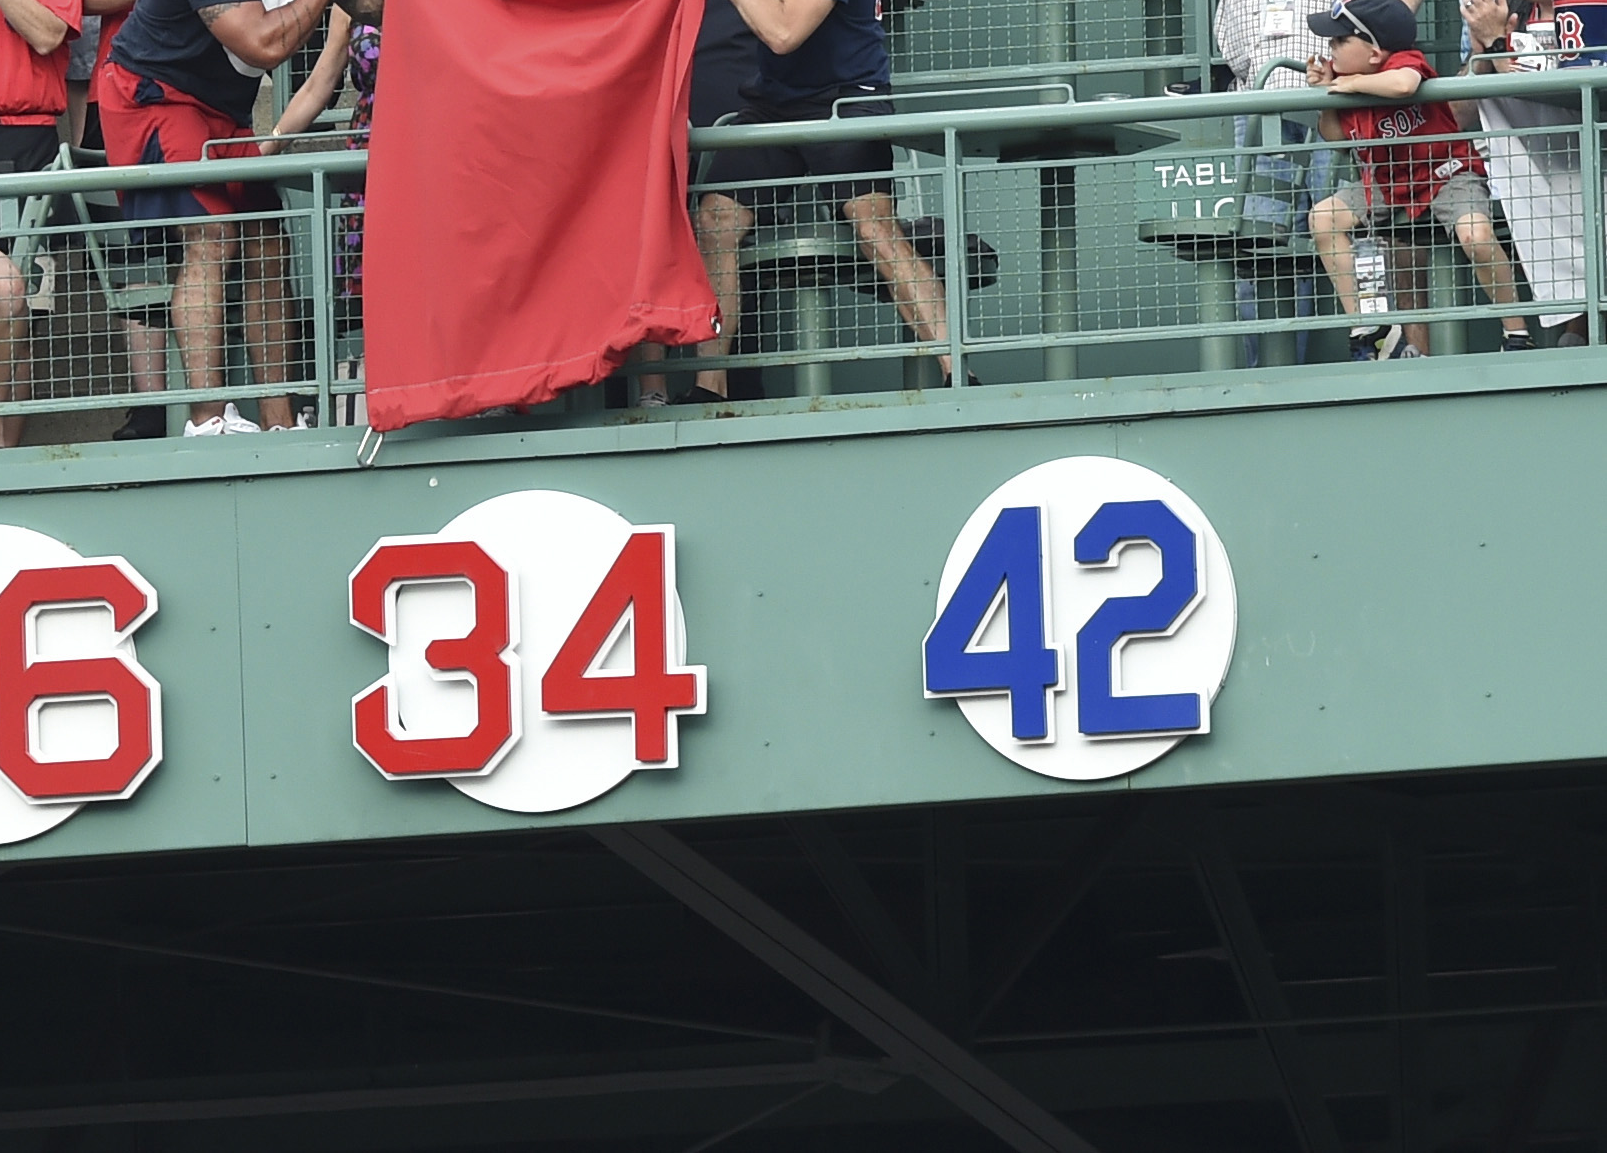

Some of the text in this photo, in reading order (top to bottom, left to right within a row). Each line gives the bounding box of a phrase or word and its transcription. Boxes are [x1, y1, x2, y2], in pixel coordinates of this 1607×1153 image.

[1555, 11, 1586, 61] B
[1378, 104, 1427, 139] SOX
[1154, 162, 1237, 188] TABL
[922, 497, 1212, 739] 42
[350, 525, 706, 778] 34
